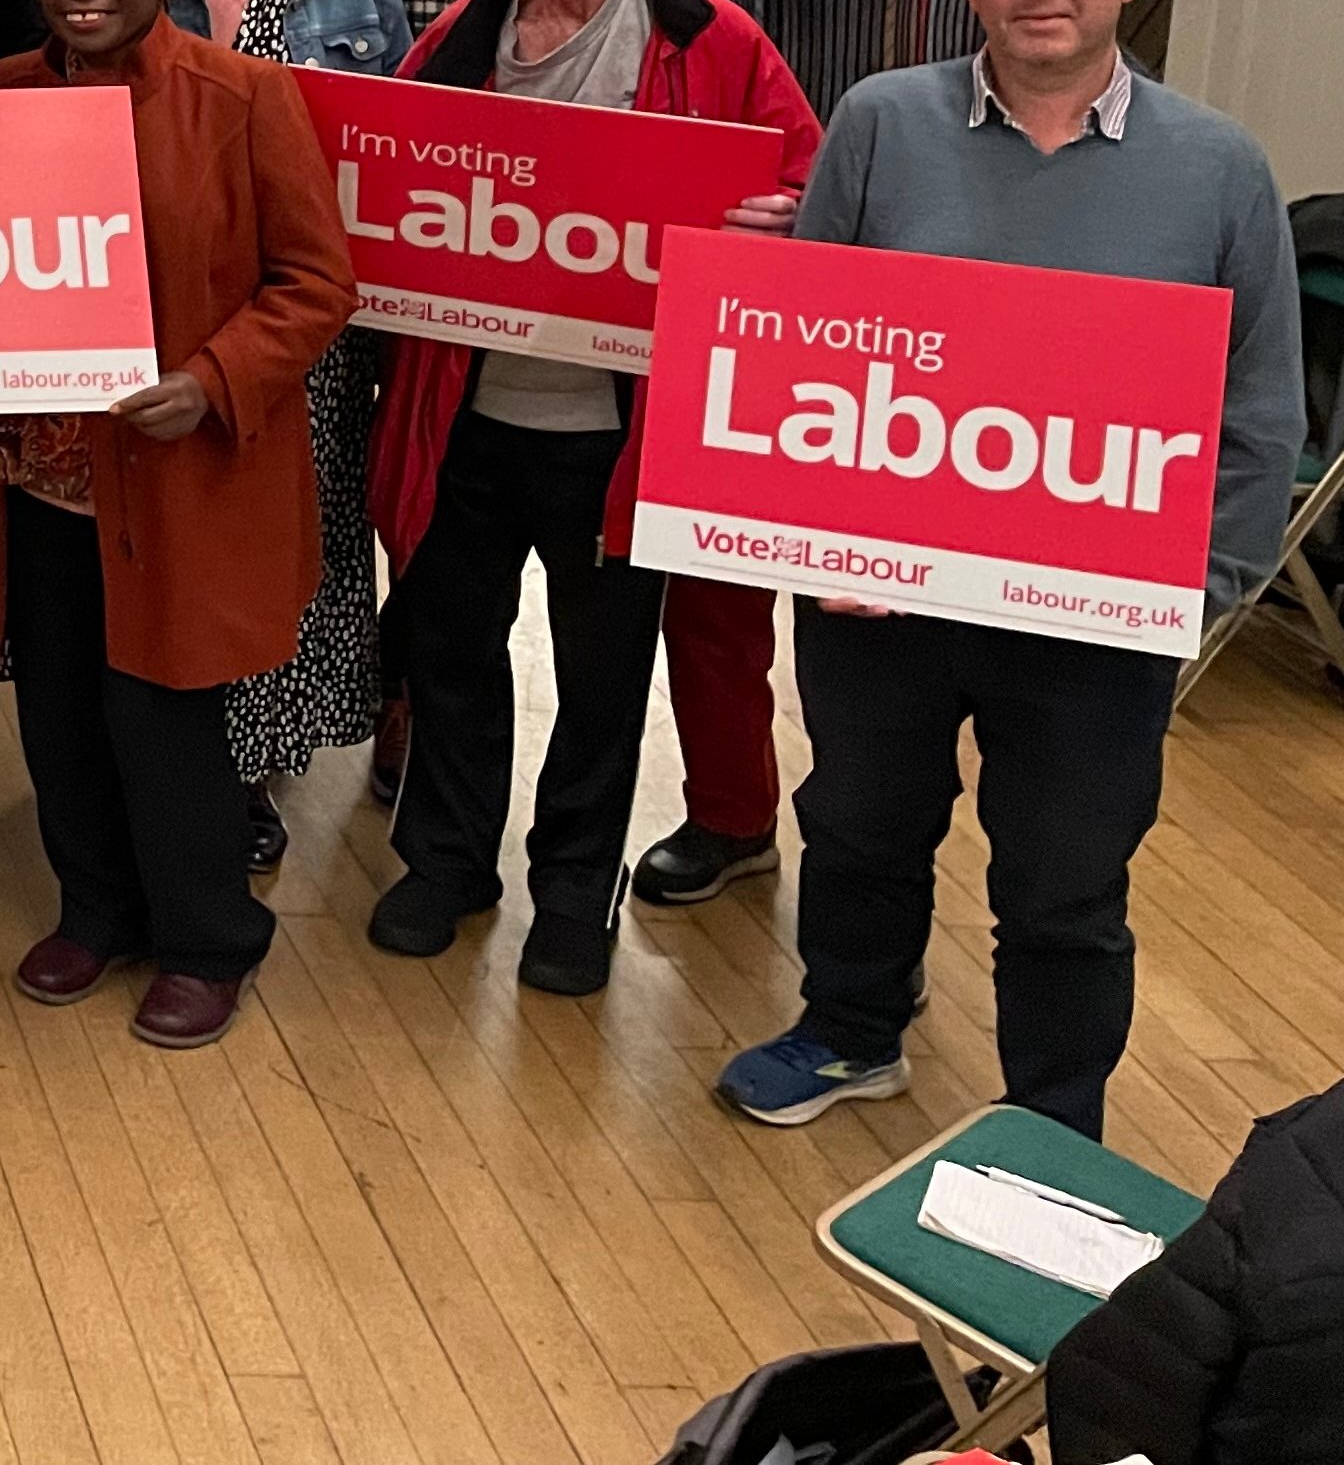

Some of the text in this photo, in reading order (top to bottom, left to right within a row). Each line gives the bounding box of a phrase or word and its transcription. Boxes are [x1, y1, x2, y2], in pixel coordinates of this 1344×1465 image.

[409, 138, 538, 187] voting
[337, 160, 660, 285] Labou
[354, 294, 535, 339] ote Labour
[797, 313, 946, 373] voting
[2, 369, 147, 392] labour.org.uk
[702, 346, 1202, 514] Labour
[693, 523, 934, 588] Vote Labour
[1002, 579, 1186, 630] labour.org.uk
